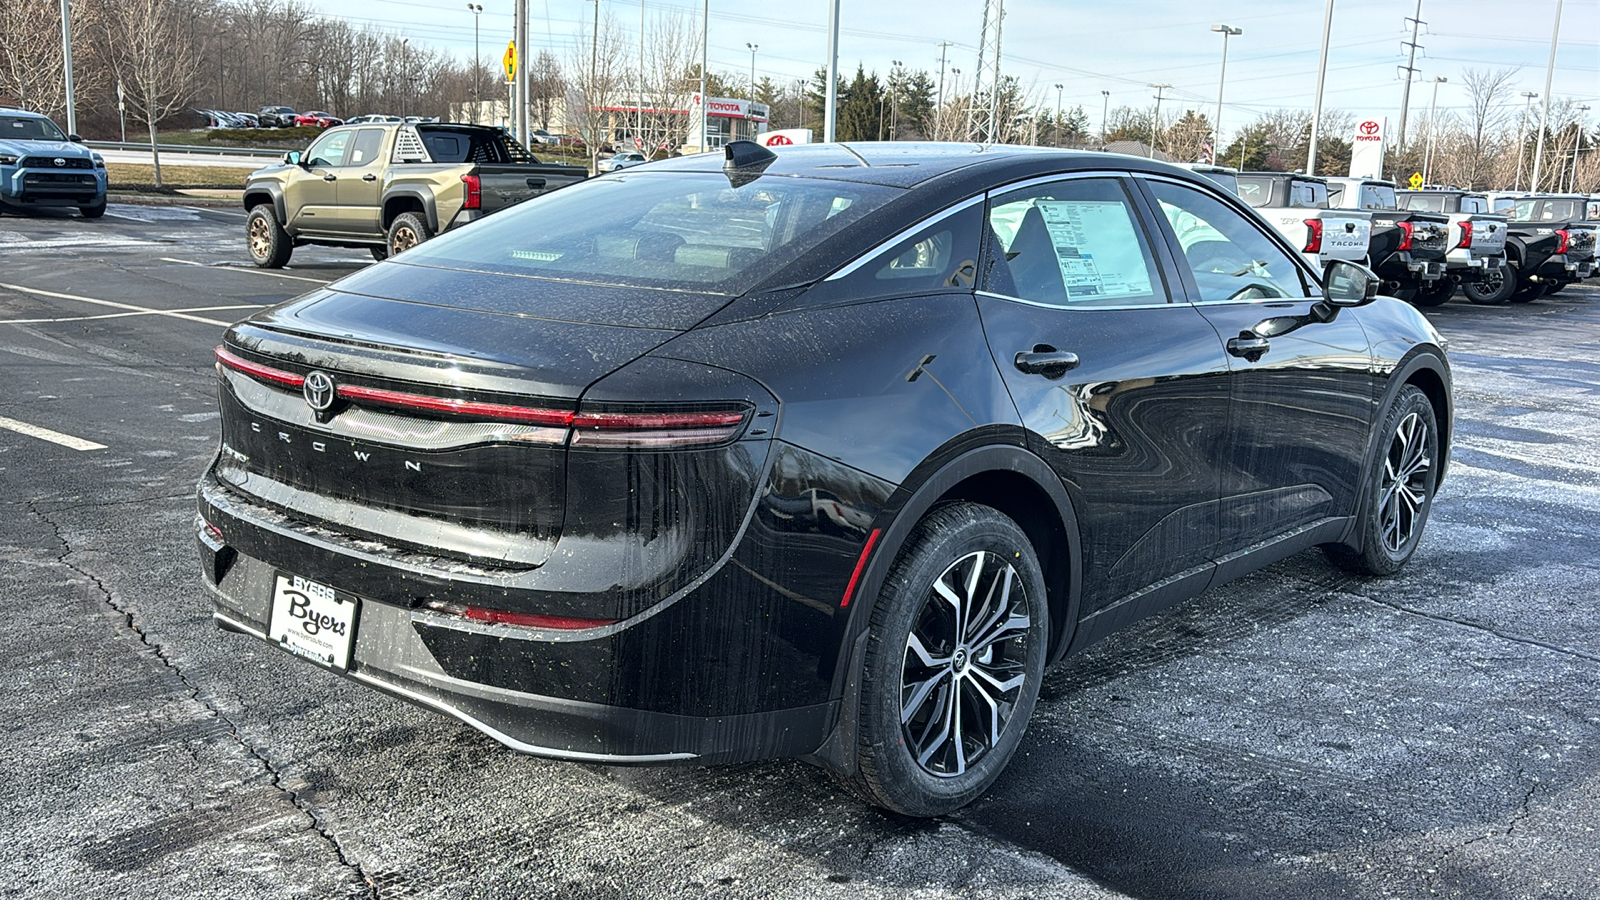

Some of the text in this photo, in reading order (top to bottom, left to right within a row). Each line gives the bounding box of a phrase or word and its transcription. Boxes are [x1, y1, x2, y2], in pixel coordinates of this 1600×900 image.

[709, 102, 740, 112] TOYOTA
[251, 422, 422, 472] CROWN
[293, 575, 336, 601] BYERS
[282, 590, 346, 636] Byers
